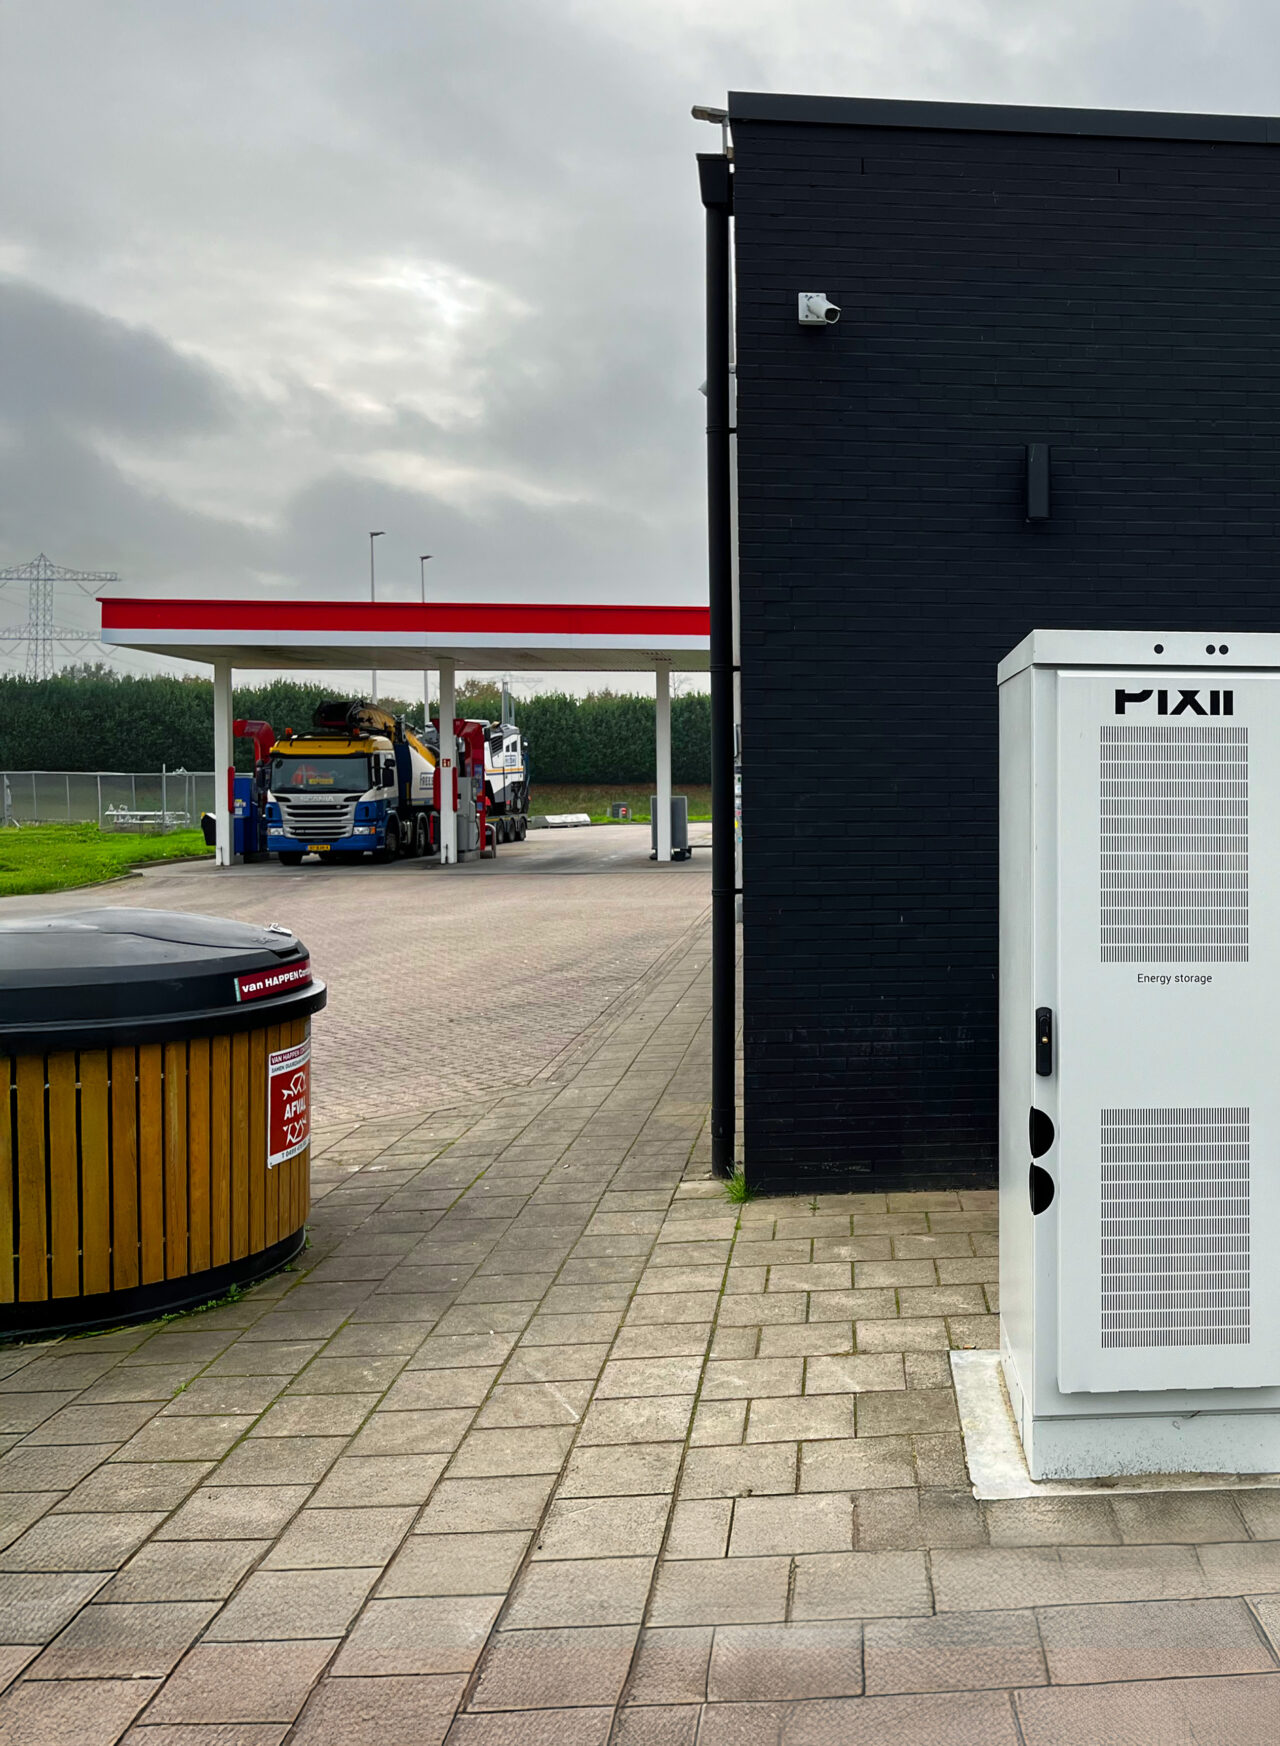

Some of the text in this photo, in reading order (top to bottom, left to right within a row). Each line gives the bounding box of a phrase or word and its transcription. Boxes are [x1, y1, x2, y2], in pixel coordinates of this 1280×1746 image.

[241, 981, 264, 993] van
[264, 970, 299, 988] HAPPEN
[1137, 973, 1213, 985] Energy storage
[271, 1055, 283, 1064] VAN
